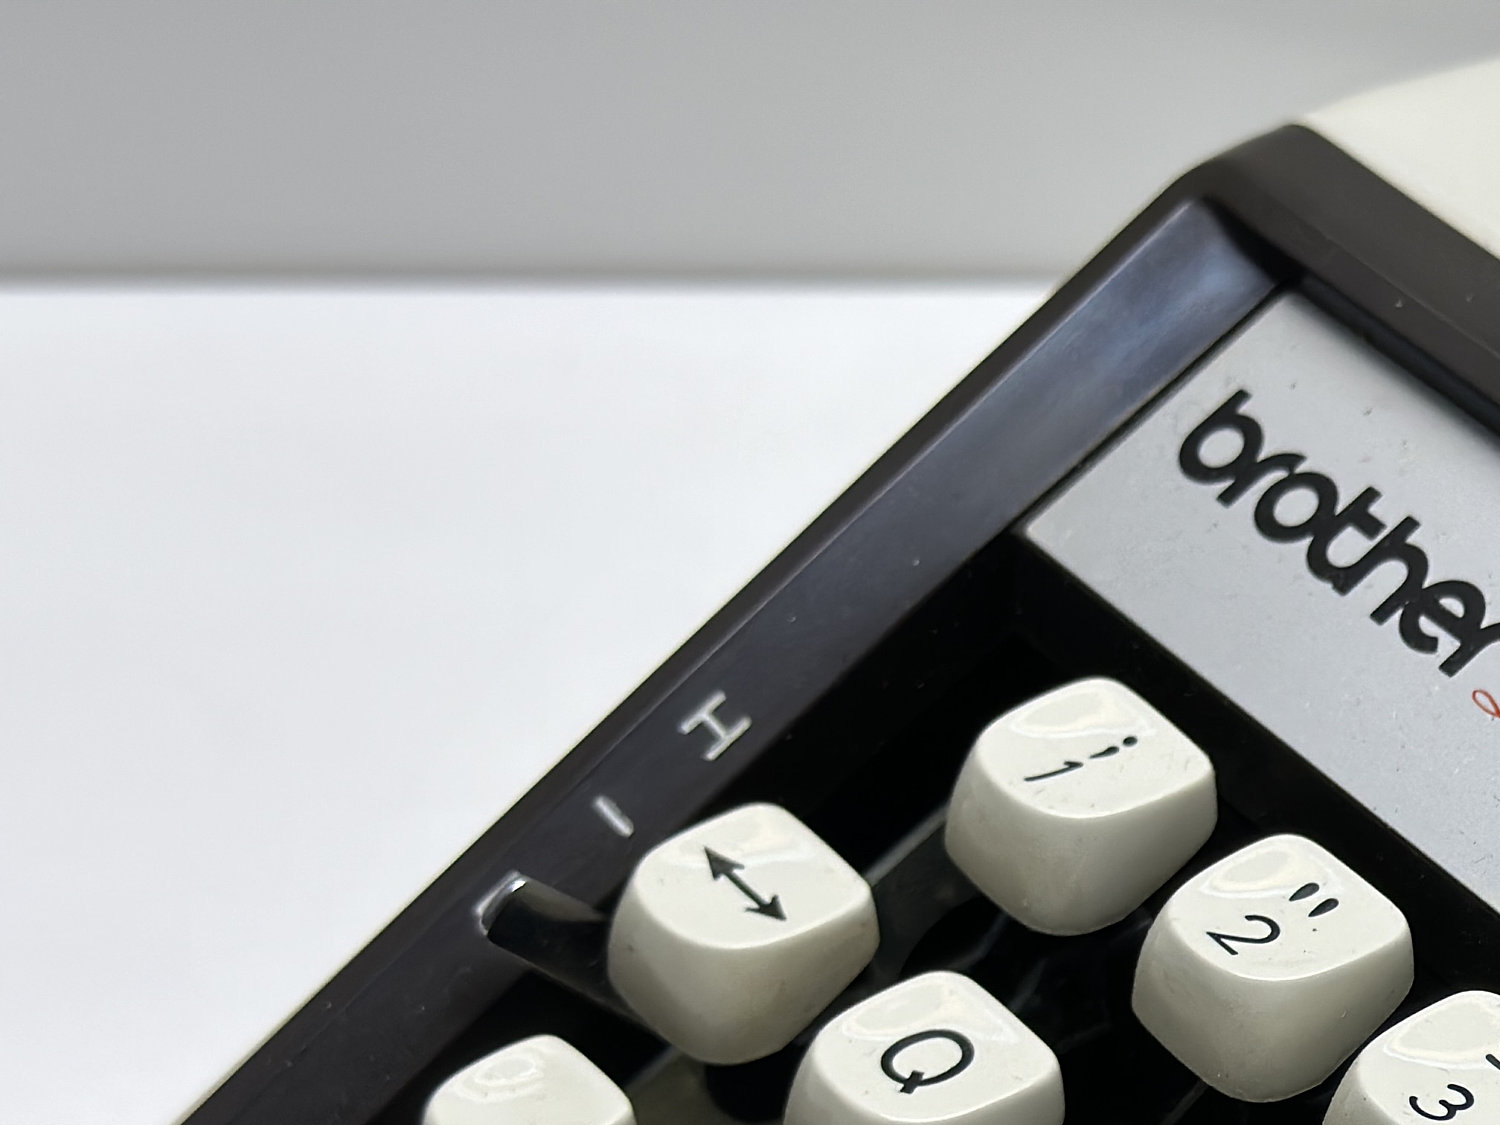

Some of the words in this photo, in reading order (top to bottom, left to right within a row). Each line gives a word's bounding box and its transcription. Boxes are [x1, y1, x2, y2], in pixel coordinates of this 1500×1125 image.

[1023, 760, 1084, 783] 1
[1205, 913, 1282, 957] 2
[879, 1028, 976, 1095] Q
[1407, 1082, 1476, 1122] 3
